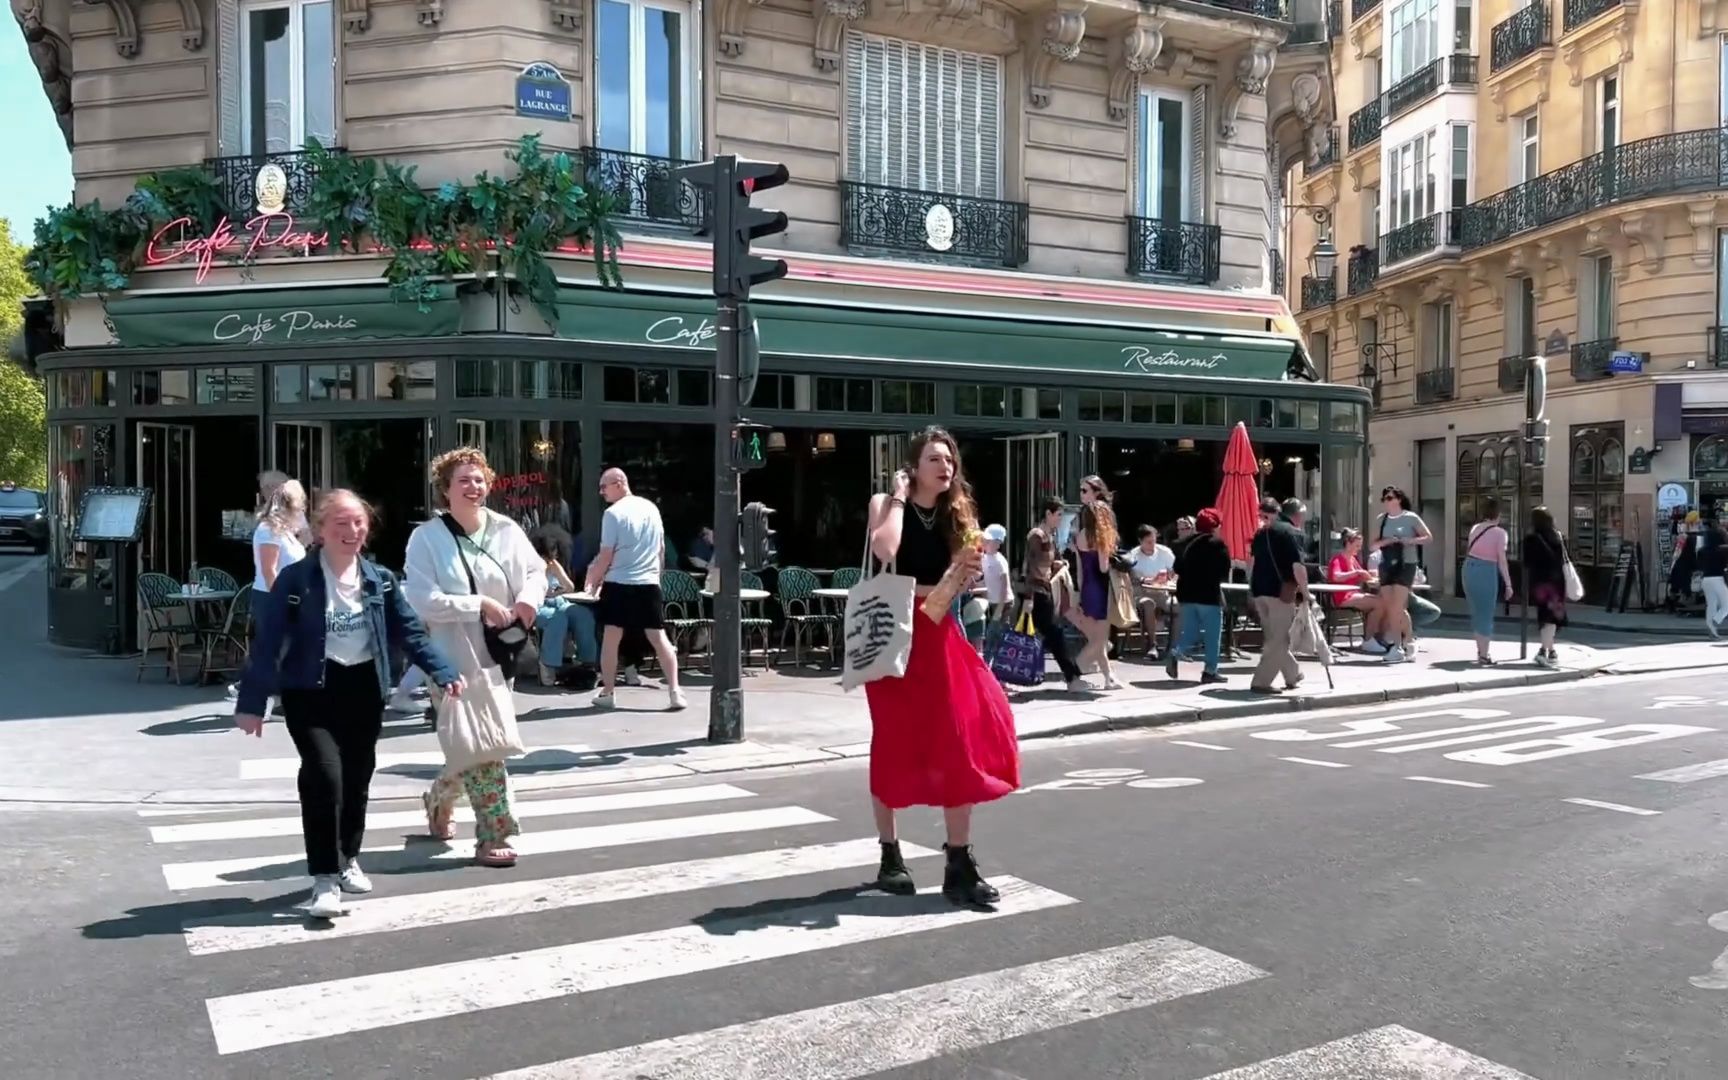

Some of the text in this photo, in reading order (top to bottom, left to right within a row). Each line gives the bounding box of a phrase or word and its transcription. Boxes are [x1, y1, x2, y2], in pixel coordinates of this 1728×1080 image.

[519, 98, 568, 113] LAGRANGE
[535, 88, 553, 100] RUE
[147, 211, 333, 285] Café Pari
[213, 310, 358, 346] Café Paris
[646, 316, 717, 346] Café
[1120, 346, 1228, 372] Restaurant
[491, 471, 547, 490] APEROL
[1249, 708, 1719, 766] BUS
